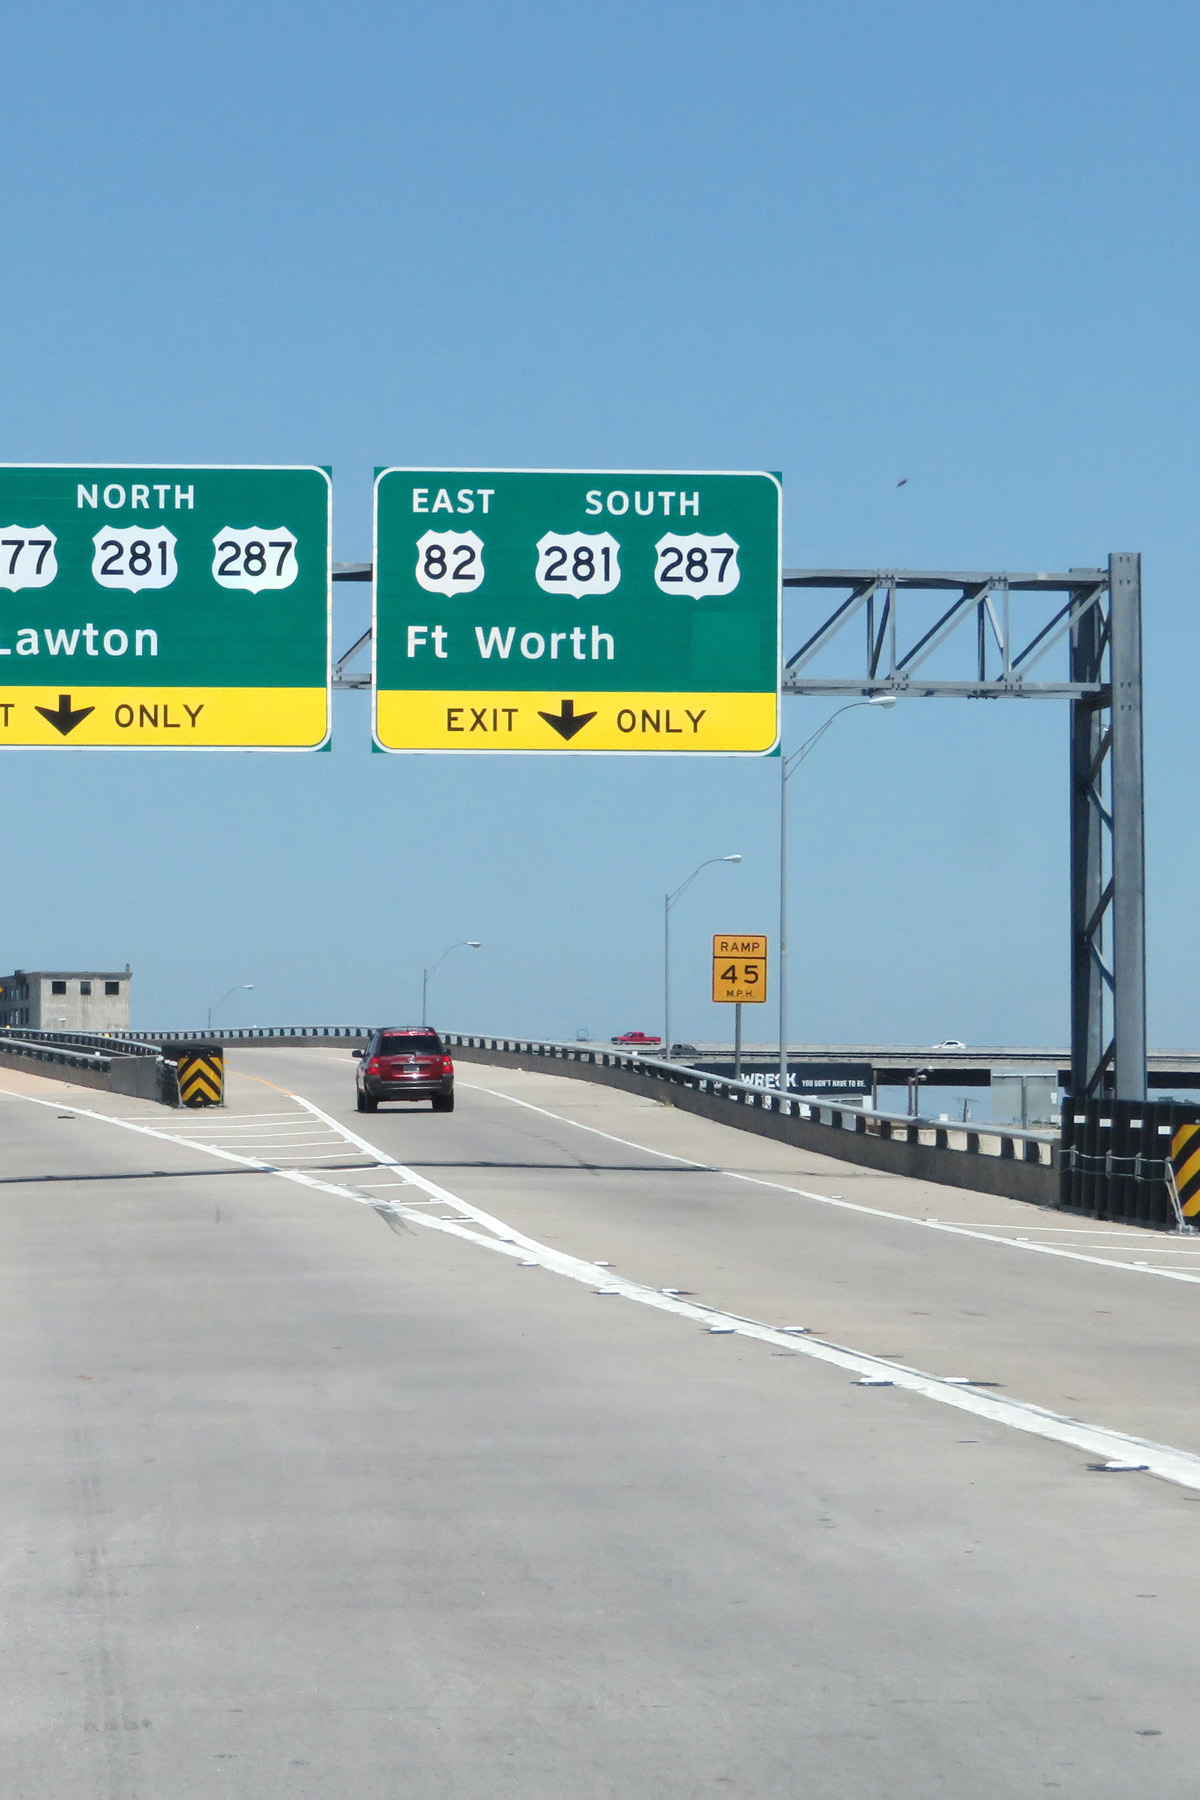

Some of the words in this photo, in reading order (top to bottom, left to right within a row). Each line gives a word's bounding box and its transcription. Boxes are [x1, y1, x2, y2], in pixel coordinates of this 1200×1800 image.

[77, 484, 195, 509] NORTH
[412, 489, 494, 514] EAST
[585, 490, 699, 516] SOUTH
[100, 540, 168, 576] 281
[218, 541, 292, 576] 287
[423, 544, 476, 580] 82
[544, 546, 609, 582] 281
[660, 547, 734, 583] 287
[407, 626, 448, 658] Ft
[475, 625, 614, 660] Worth
[115, 703, 204, 728] ONLY
[448, 708, 518, 731] EXIT
[617, 709, 706, 733] ONLY
[721, 942, 759, 952] RAMP
[721, 965, 758, 984] 45
